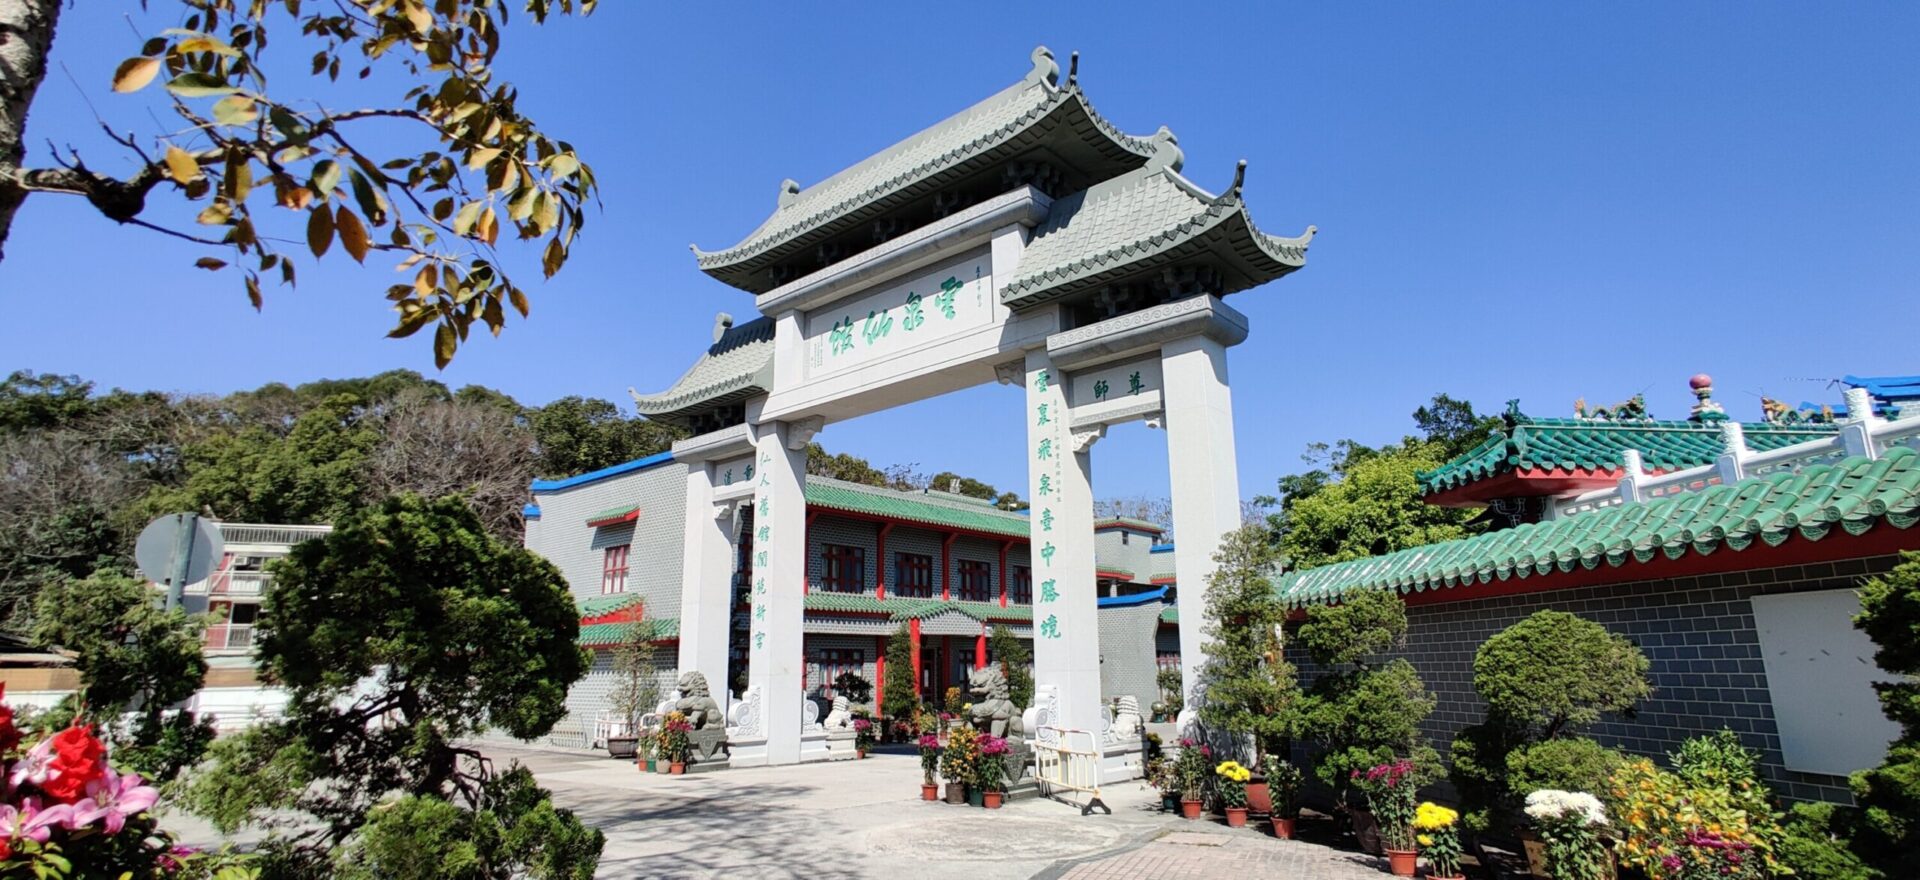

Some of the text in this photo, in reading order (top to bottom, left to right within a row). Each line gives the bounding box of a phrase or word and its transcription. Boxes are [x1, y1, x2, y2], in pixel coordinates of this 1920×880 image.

[829, 276, 963, 356] 雲泉仙館
[1093, 371, 1145, 401] 尊師
[723, 464, 753, 486] 重道
